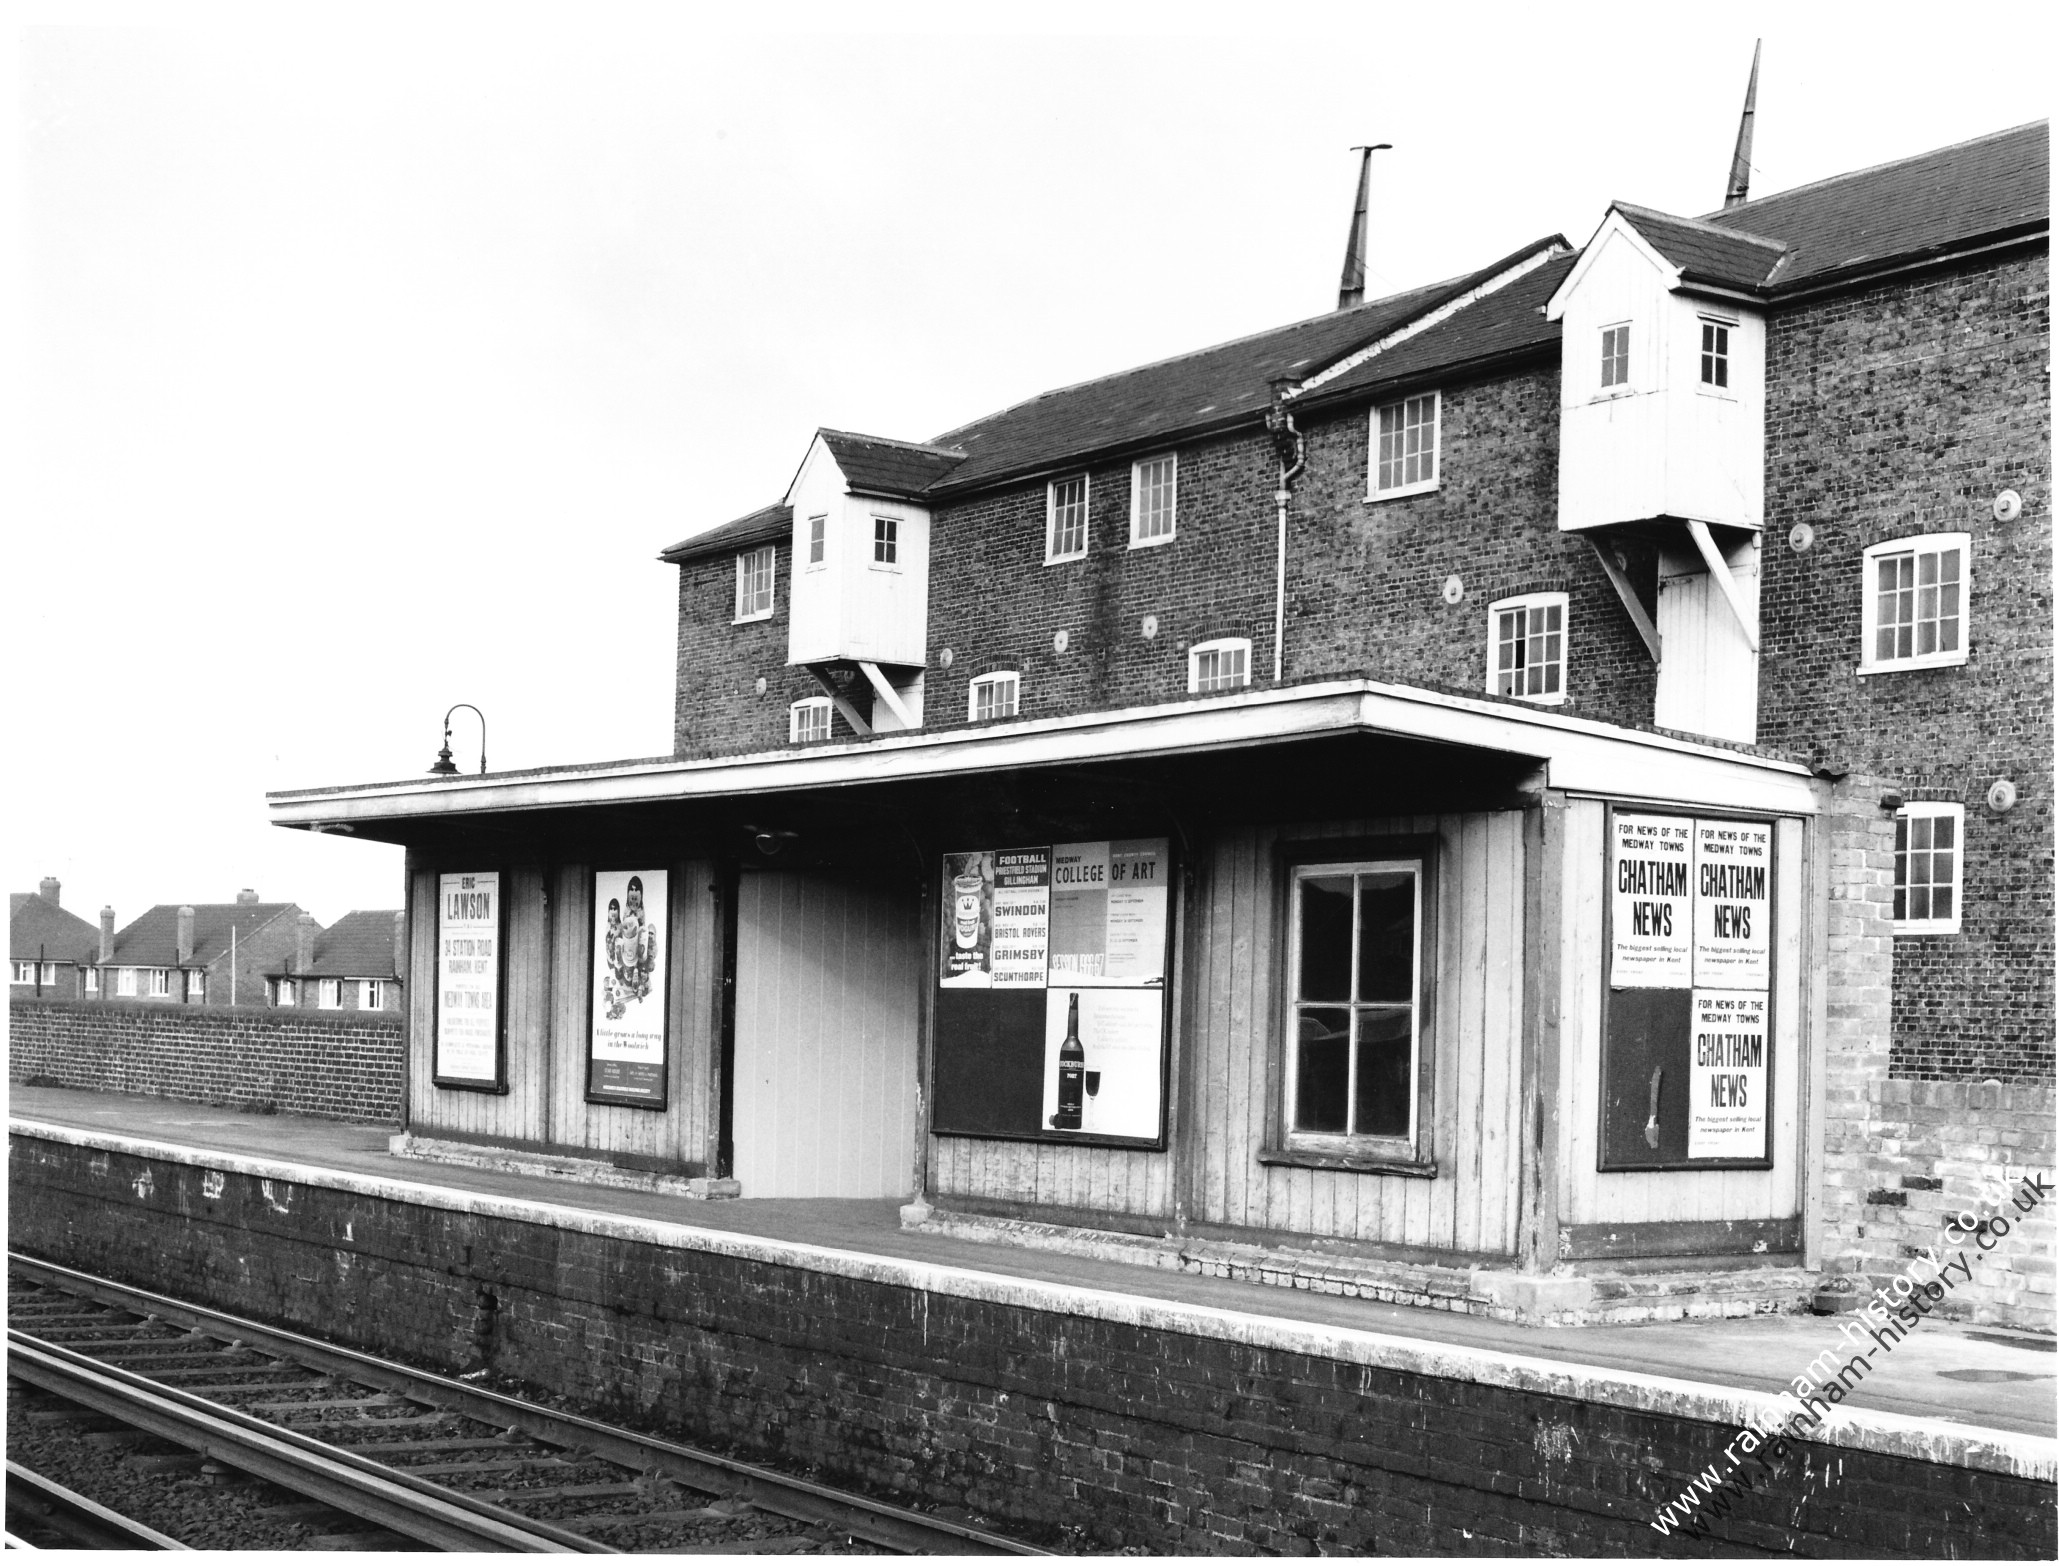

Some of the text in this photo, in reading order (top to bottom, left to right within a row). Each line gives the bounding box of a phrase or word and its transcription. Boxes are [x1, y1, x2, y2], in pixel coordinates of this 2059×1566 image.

[1619, 824, 1689, 838] FOR NEWS OF THE
[1701, 829, 1766, 843] FOR NEWS OF THE
[1622, 839, 1684, 852] MEDWAY TOWNS
[1704, 843, 1762, 856] MEDWAY TOWNS
[999, 854, 1046, 865] FOOTBALL
[1056, 856, 1081, 864] MEDWAY
[996, 864, 1047, 875] PRIESTFIELD STADIUM
[1056, 862, 1155, 884] COLLEGE OF ART
[462, 877, 475, 889] ERIC
[1004, 875, 1038, 885] GILLINGHAM
[1619, 859, 1687, 897] CHATHAM
[1700, 863, 1765, 900] CHATHAM
[447, 892, 490, 920] LAWSON
[995, 904, 1045, 917] SWINDON
[1633, 901, 1672, 936] NEWS
[1714, 904, 1750, 939] NEWS
[995, 927, 1046, 938] BRISTOL ROVERS
[452, 939, 476, 957] STATION
[477, 939, 492, 957] ROAD
[1629, 944, 1652, 952] biggest
[1654, 945, 1672, 953] selling
[1711, 946, 1732, 954] biggest
[973, 951, 983, 960] the
[995, 949, 1045, 960] GRIMSBY
[474, 960, 488, 974] KENT
[994, 972, 1044, 982] SCUNTHORPE
[1698, 1000, 1764, 1011] FOR NEWS OF THE
[1701, 1013, 1760, 1024] MEDWAY TOWNS
[600, 1028, 613, 1036] little
[623, 1041, 649, 1049] Woolwich
[1697, 1033, 1762, 1067] CHATHAM
[1711, 1074, 1747, 1108] NEWS
